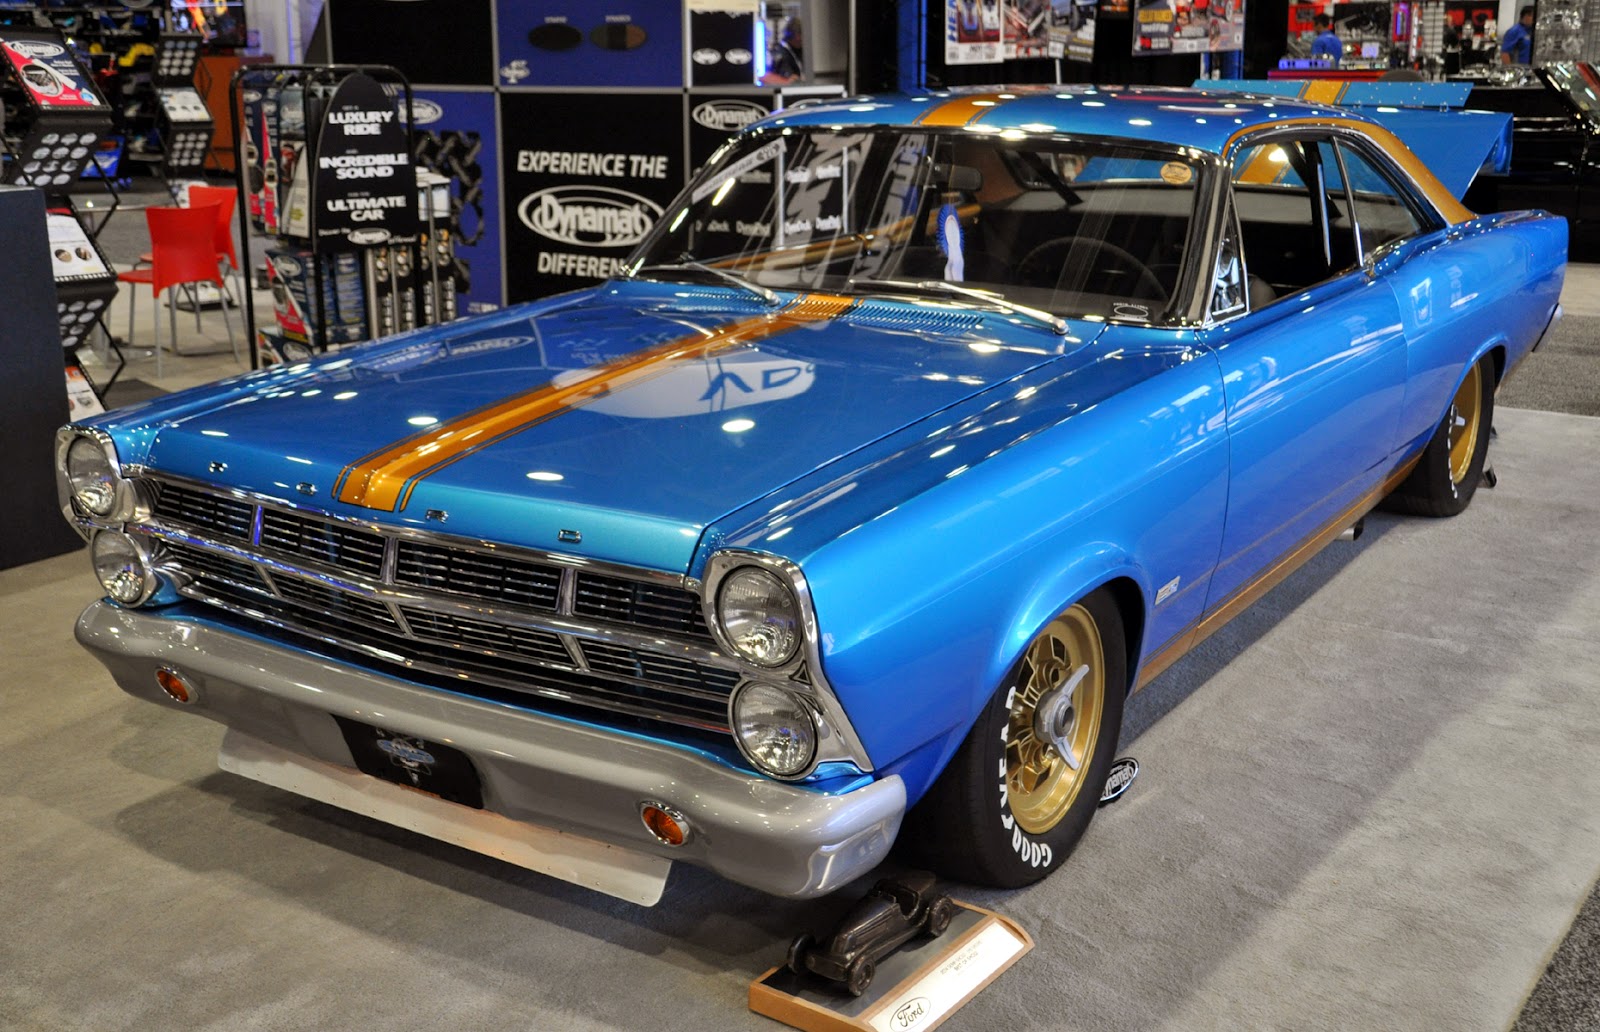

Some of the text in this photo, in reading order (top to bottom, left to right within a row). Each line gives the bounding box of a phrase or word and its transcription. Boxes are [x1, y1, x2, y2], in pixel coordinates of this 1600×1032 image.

[328, 111, 393, 124] LUXURY
[343, 123, 381, 136] RIDE
[319, 153, 409, 169] INCREDIBLE
[516, 150, 626, 177] EXPERIENCE
[629, 155, 669, 179] THE
[336, 166, 394, 180] SOUND
[326, 196, 407, 212] ULTIMATE
[350, 209, 385, 222] CAR
[540, 193, 643, 236] Dynamat
[537, 252, 626, 279] DIFFEREN
[896, 1003, 925, 1027] Ford
